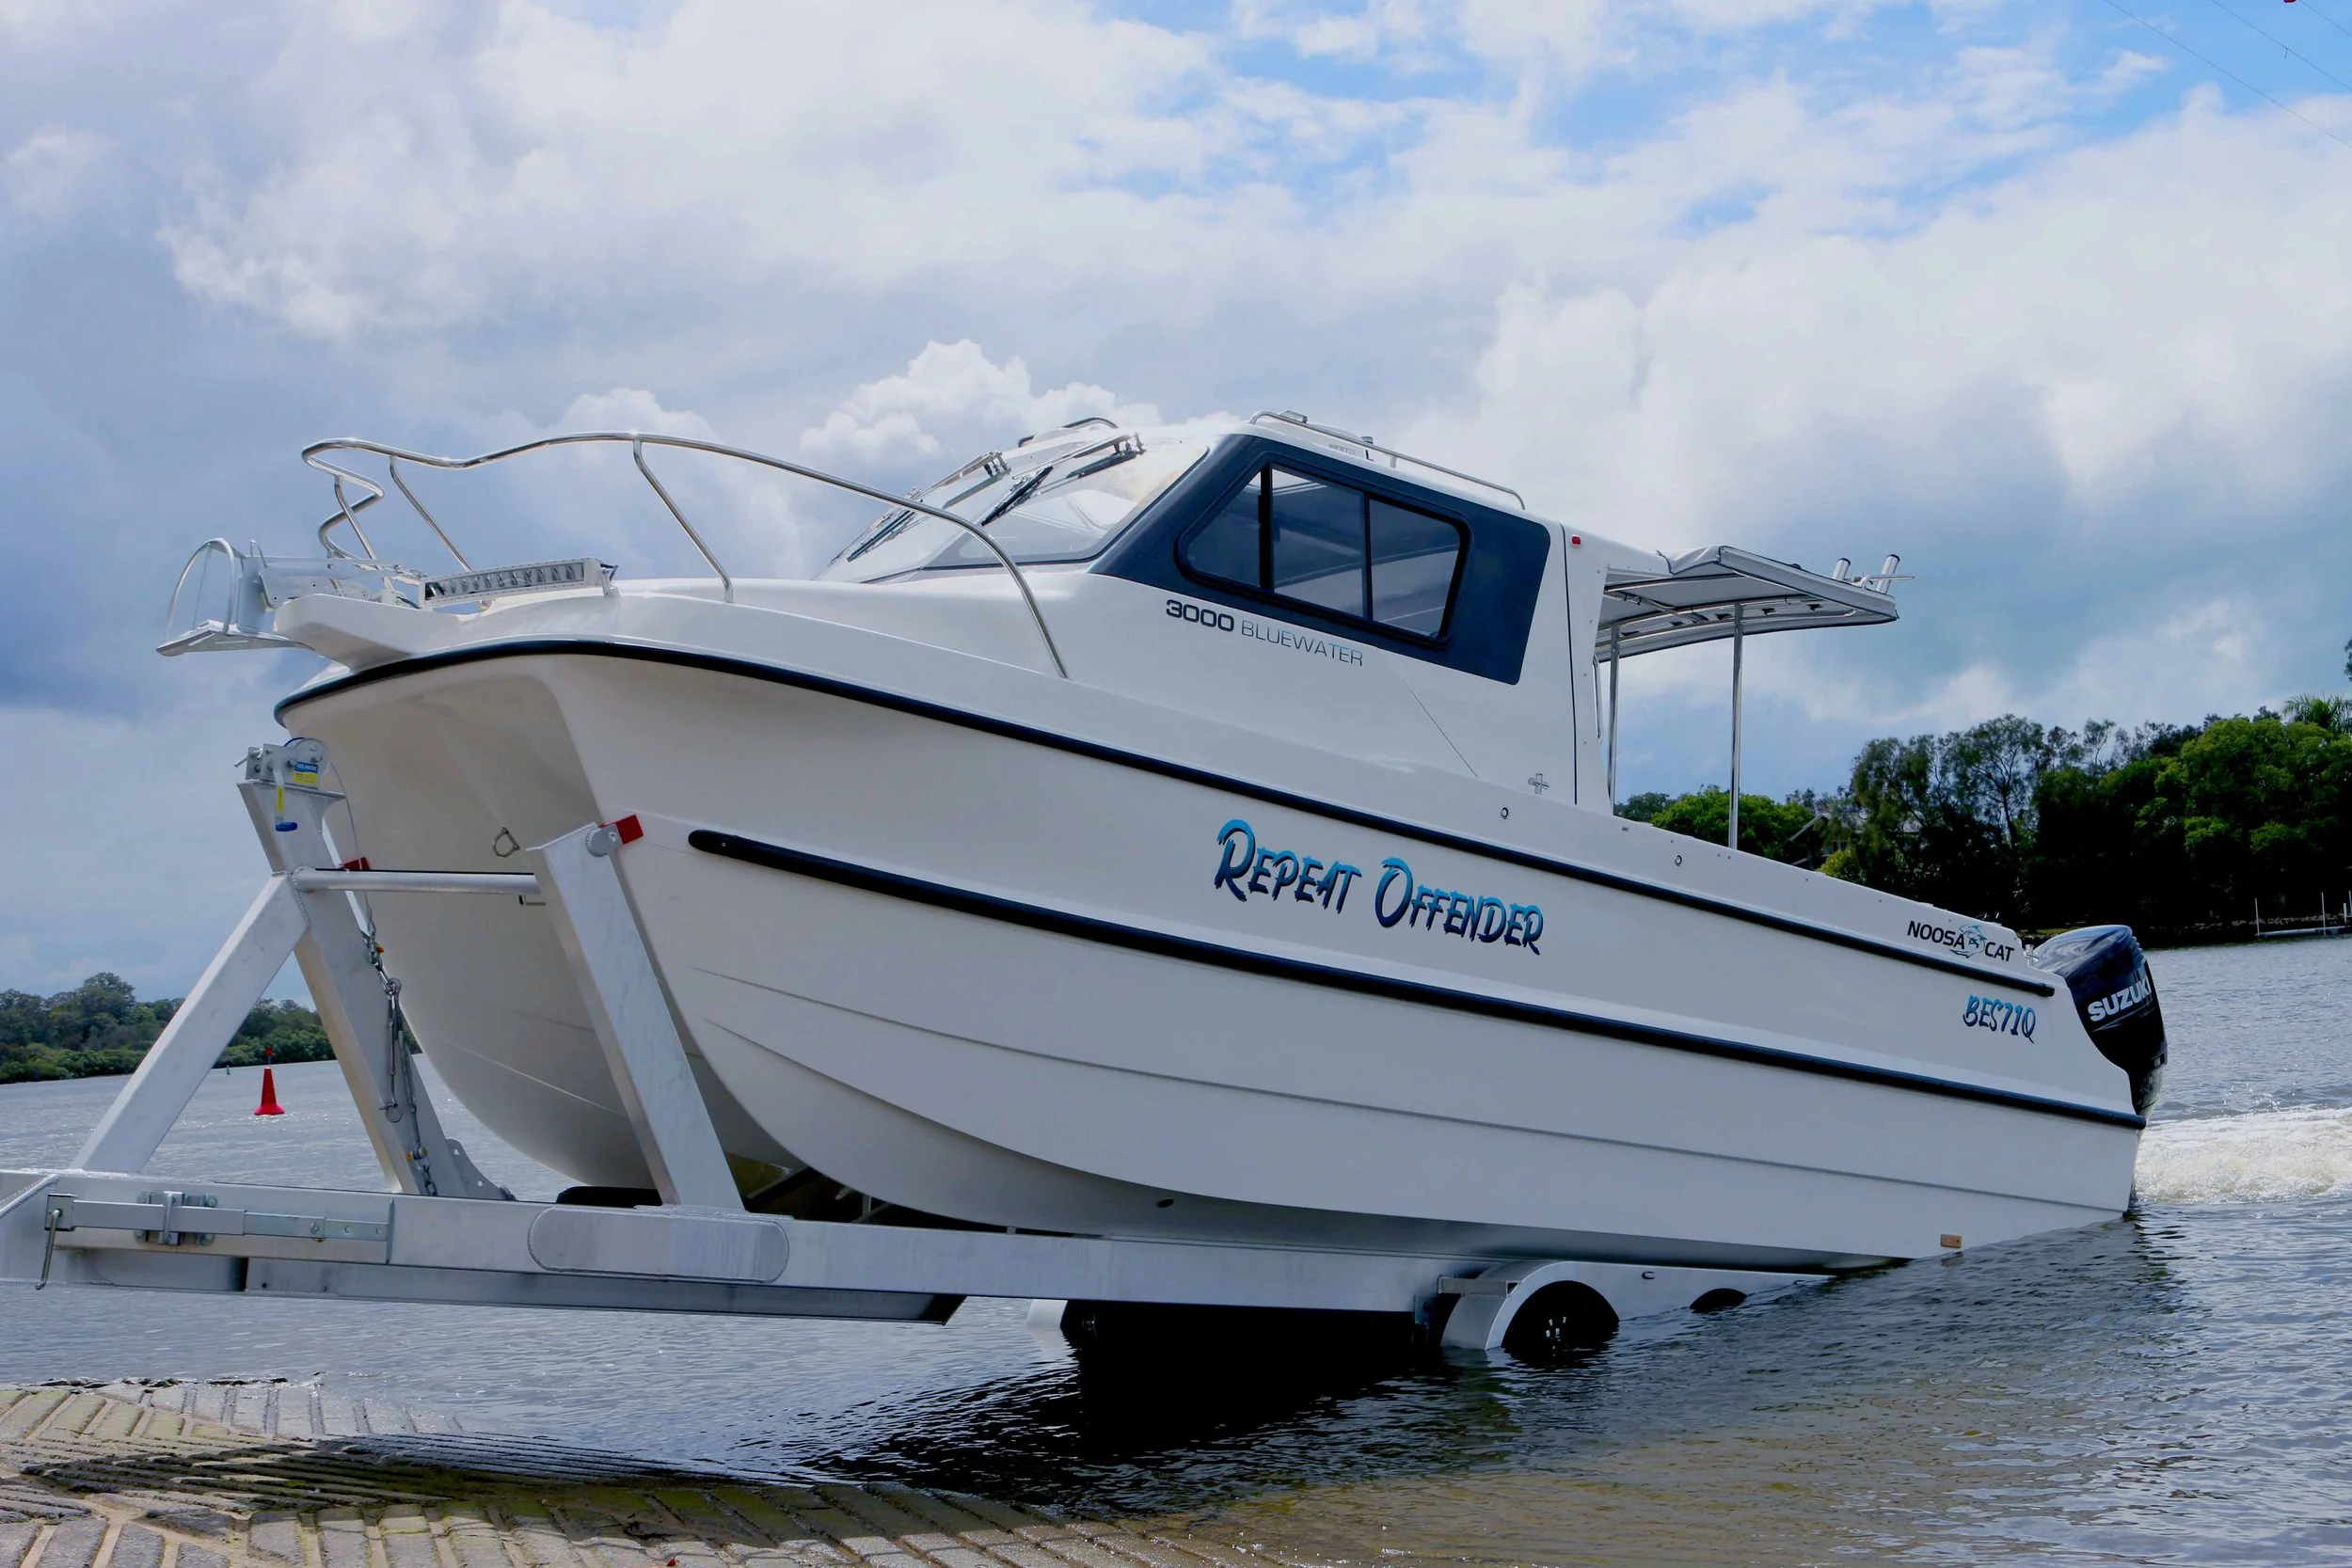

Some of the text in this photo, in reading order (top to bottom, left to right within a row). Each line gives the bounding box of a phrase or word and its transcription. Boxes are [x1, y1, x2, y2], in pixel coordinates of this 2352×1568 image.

[1166, 599, 1363, 666] 3000 BLUEWATER
[1214, 818, 1544, 956] REPEAT OFFENDER
[1907, 920, 2015, 961] NOOSA CAT
